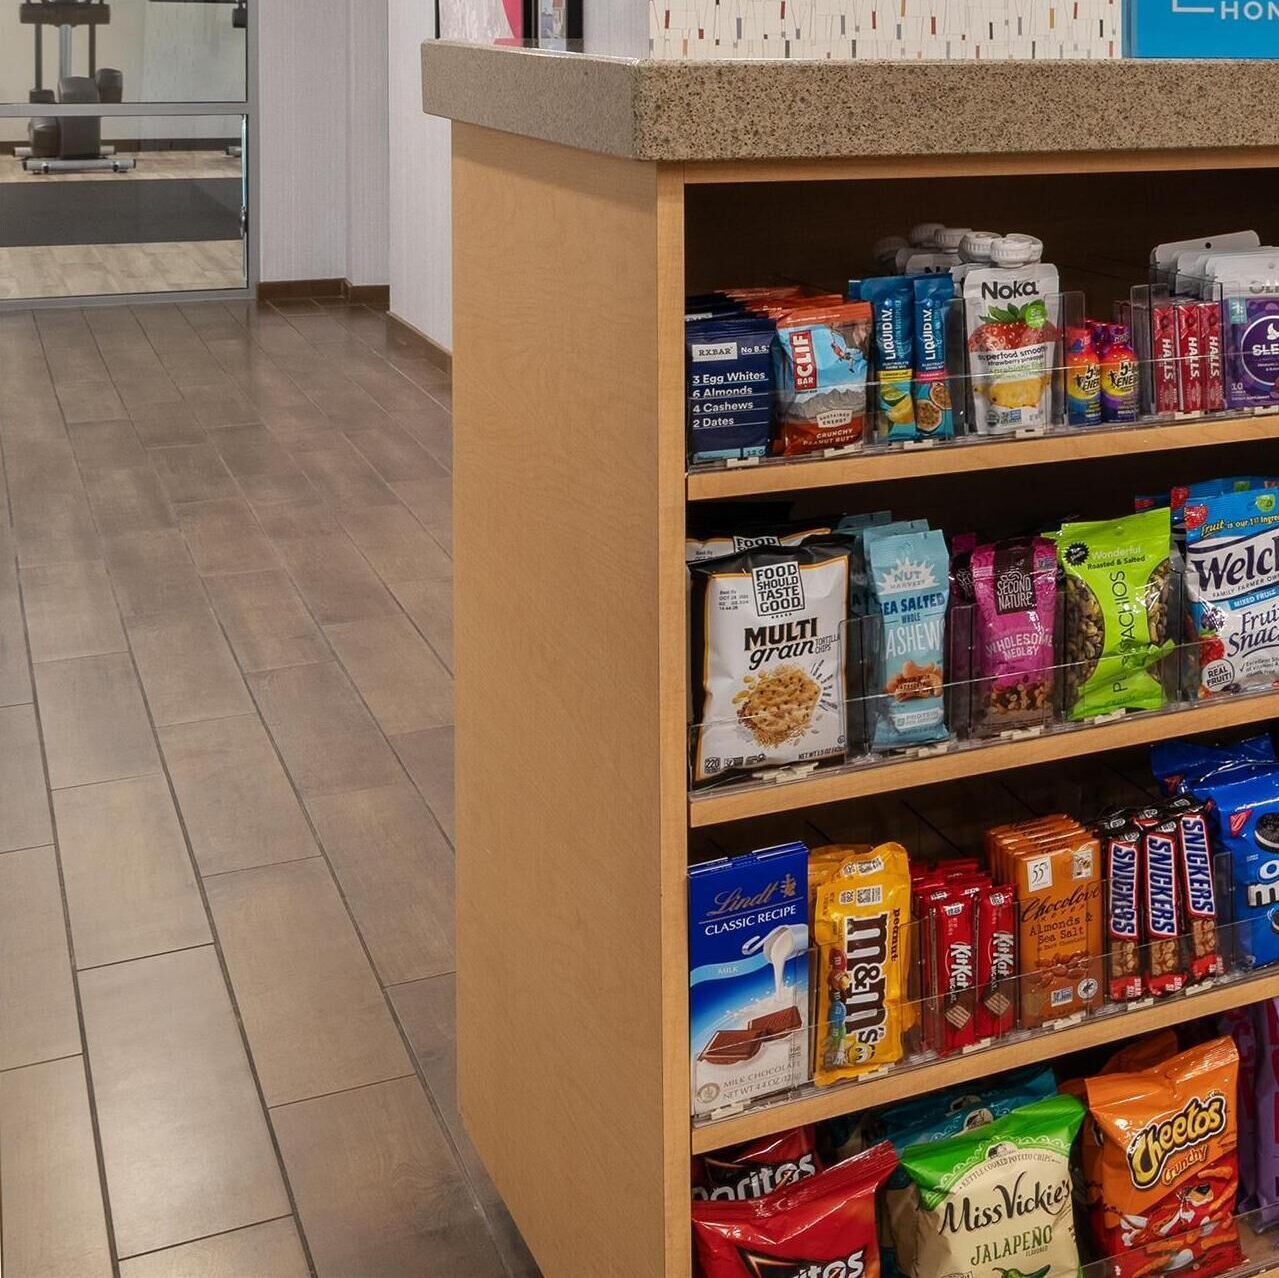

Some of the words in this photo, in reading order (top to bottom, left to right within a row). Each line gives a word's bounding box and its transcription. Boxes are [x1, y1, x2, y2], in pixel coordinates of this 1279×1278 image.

[981, 280, 1039, 300] Noka
[882, 322, 896, 360] LIQUID
[923, 323, 936, 360] LIQUID
[698, 347, 732, 357] RXBAR
[793, 335, 813, 377] CLIF
[1162, 338, 1173, 382] HALLS
[1188, 337, 1200, 380] HALLS
[1208, 335, 1220, 377] HALLS
[693, 375, 699, 384] 3
[703, 374, 724, 384] Egg
[727, 371, 766, 382] Whites
[797, 377, 814, 385] BAR
[693, 390, 700, 398] 6
[703, 386, 752, 397] Almonds
[693, 404, 700, 413] 4
[703, 400, 753, 412] Cashews
[703, 417, 734, 427] Dates
[817, 428, 853, 438] CRUNCHY
[1091, 545, 1141, 559] Wonderful
[1087, 559, 1115, 570] Roasted
[1117, 558, 1122, 566] &
[1124, 555, 1145, 565] Salted
[756, 564, 797, 581] FOOD
[893, 570, 921, 583] NUT
[756, 576, 798, 591] SHOULD
[997, 577, 1032, 596] SECOND
[1213, 588, 1235, 598] FAMILY
[1238, 580, 1265, 593] FARMER
[758, 585, 800, 602] TASTE
[901, 592, 945, 611] SALTED
[998, 592, 1033, 611] NATURE
[1234, 596, 1255, 608] MIXED
[760, 597, 801, 613] GOOD
[901, 613, 920, 624] WHOLE
[744, 617, 818, 651] MULTI
[815, 633, 840, 645] TORTILLA
[885, 620, 944, 660] ASHEW
[749, 640, 814, 670] grain
[815, 643, 831, 654] CHIPS
[1207, 667, 1228, 678] REAL
[1207, 672, 1232, 686] FRUIT!
[1183, 819, 1214, 912] SNICKERS
[1113, 845, 1136, 935] SNICKERS
[1150, 837, 1176, 935] SNICKERS
[706, 881, 779, 917] Lindt
[1022, 885, 1099, 921] Chocolove
[705, 914, 755, 936] CLASSIC
[757, 904, 797, 924] RECIPE
[1029, 917, 1080, 936] Almonds
[1085, 913, 1093, 922] &
[891, 908, 901, 962] peanut
[1039, 935, 1056, 944] Sea
[1060, 927, 1084, 940] Salt
[718, 966, 739, 975] MILK
[723, 1076, 745, 1088] MILK
[740, 1085, 753, 1095] WT
[1130, 1096, 1225, 1187] Cheetos
[961, 1168, 985, 1187] KETTLE
[984, 1158, 1008, 1171] COOKED
[1162, 1144, 1209, 1185] Crunchy
[939, 1197, 1001, 1235] Miss
[993, 1171, 1071, 1219] Vickie's
[971, 1224, 1053, 1266] JALAPEÑO
